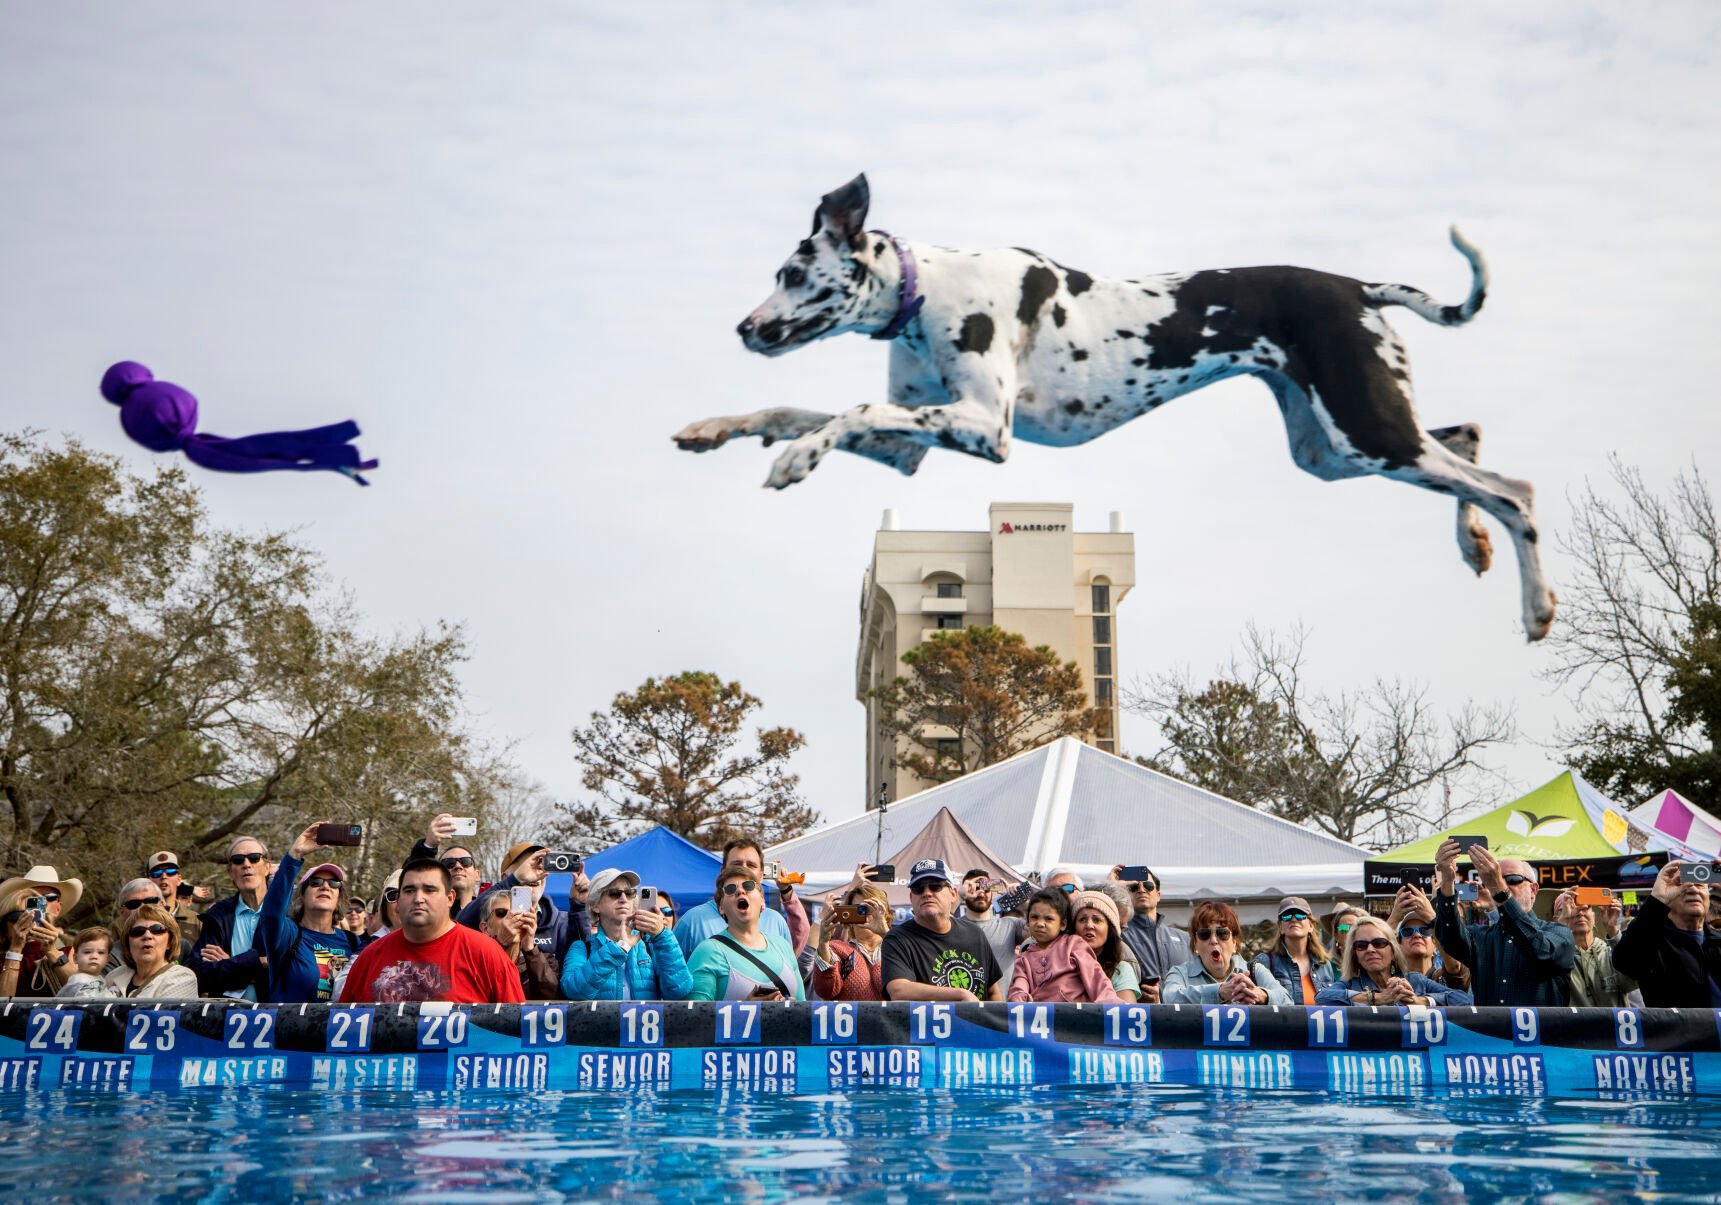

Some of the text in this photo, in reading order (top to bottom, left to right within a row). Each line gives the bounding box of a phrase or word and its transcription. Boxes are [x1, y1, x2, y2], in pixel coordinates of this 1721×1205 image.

[1014, 524, 1066, 532] MARRIOTT
[1371, 874, 1386, 885] The
[533, 937, 552, 945] ORT
[30, 1002, 1639, 1051] 24 23 22 21 20 19 18 17 16 15 14 13 12 11 10 9 8
[0, 1060, 39, 1090] ITE
[181, 1058, 286, 1085] MASTER
[313, 1057, 416, 1087] MASTER
[456, 1054, 548, 1086] SENIOR
[580, 1053, 671, 1084] SENIOR
[704, 1050, 796, 1080] SENIOR
[829, 1049, 920, 1077] SENIOR
[943, 1050, 1033, 1081] JUNIOR
[1072, 1052, 1163, 1083] JUNIOR
[1446, 1055, 1541, 1083] NOVICE
[1595, 1055, 1694, 1084] NOVICE
